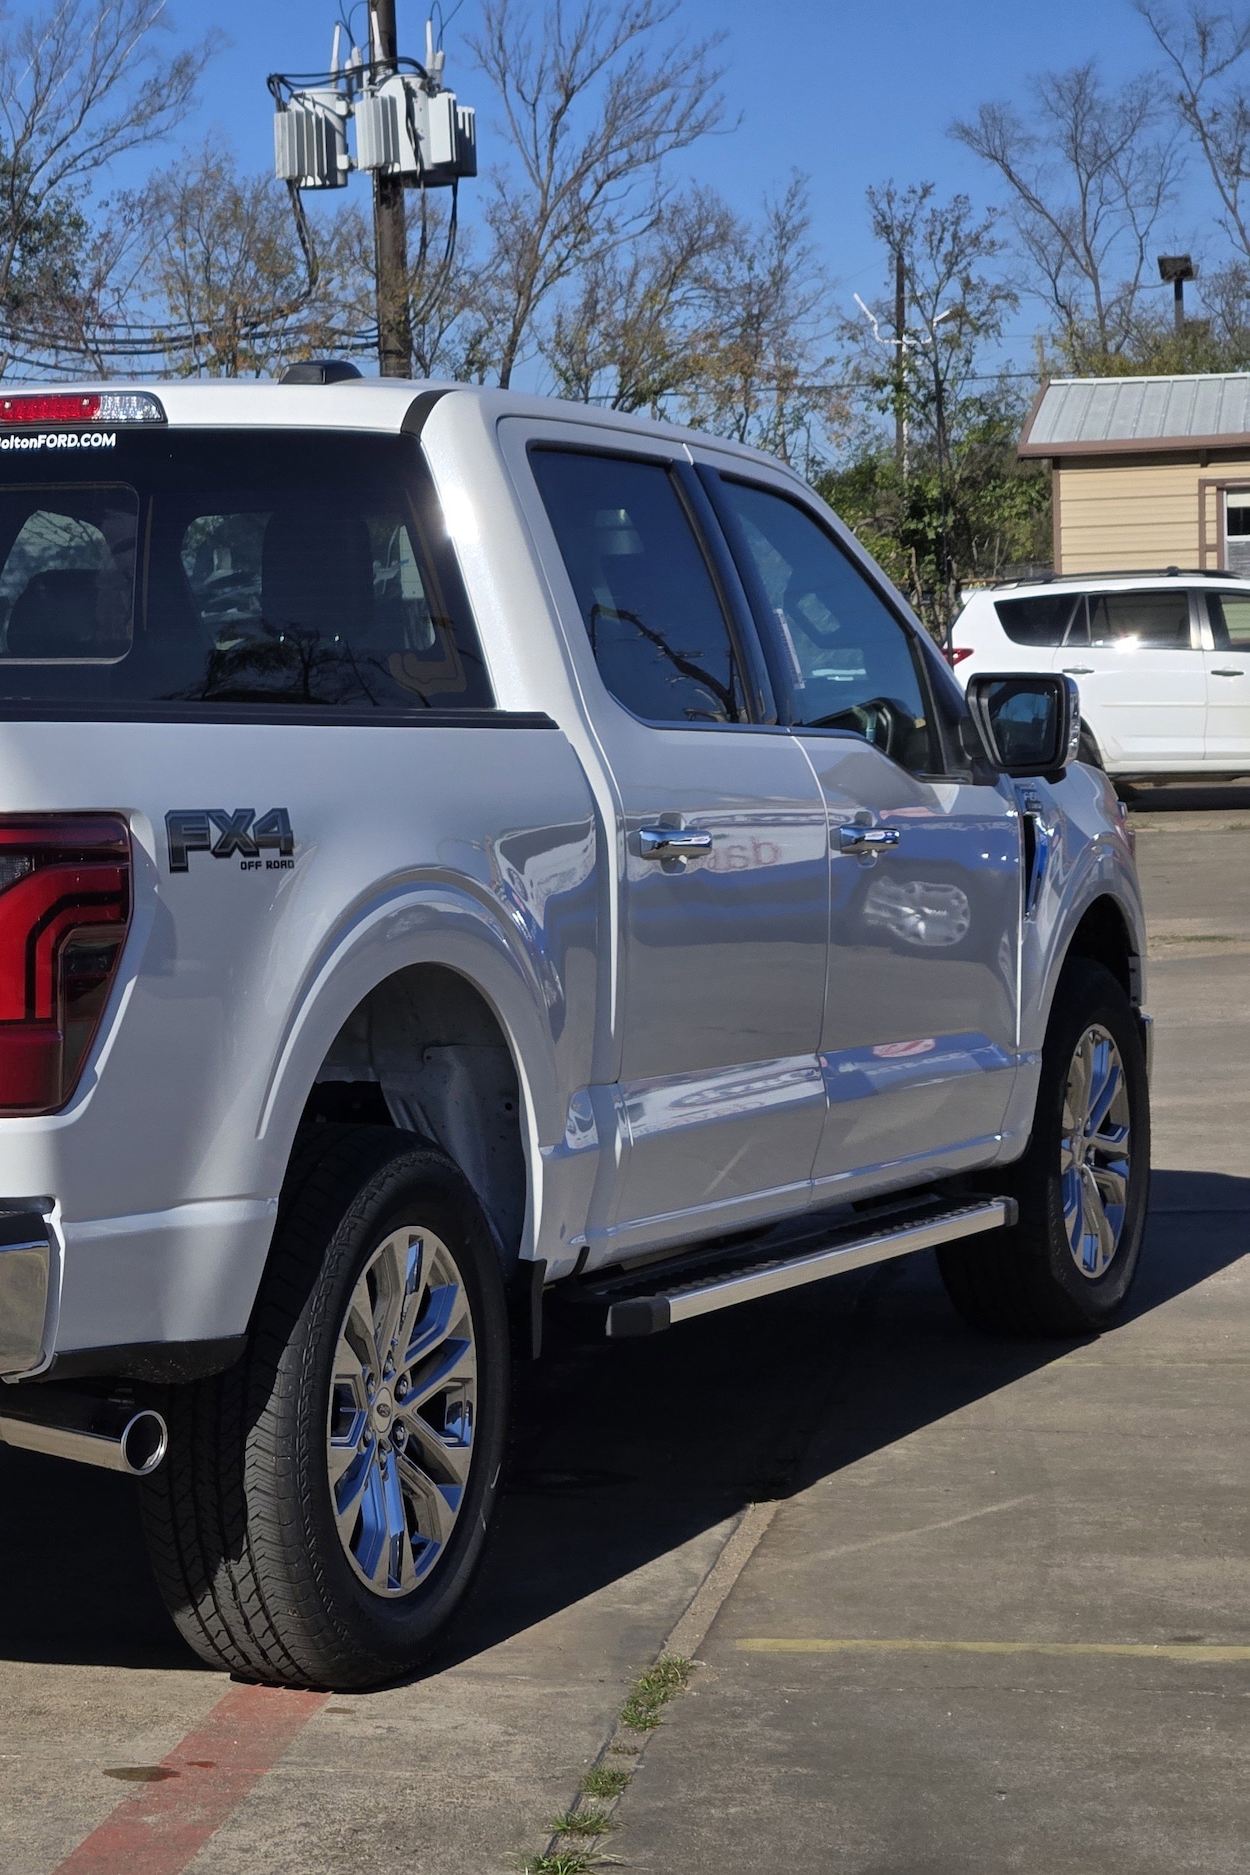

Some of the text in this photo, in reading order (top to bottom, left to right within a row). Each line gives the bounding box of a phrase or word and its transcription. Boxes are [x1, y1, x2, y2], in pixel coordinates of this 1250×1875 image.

[164, 807, 295, 873] FX4
[240, 859, 295, 871] OFF ROAD
